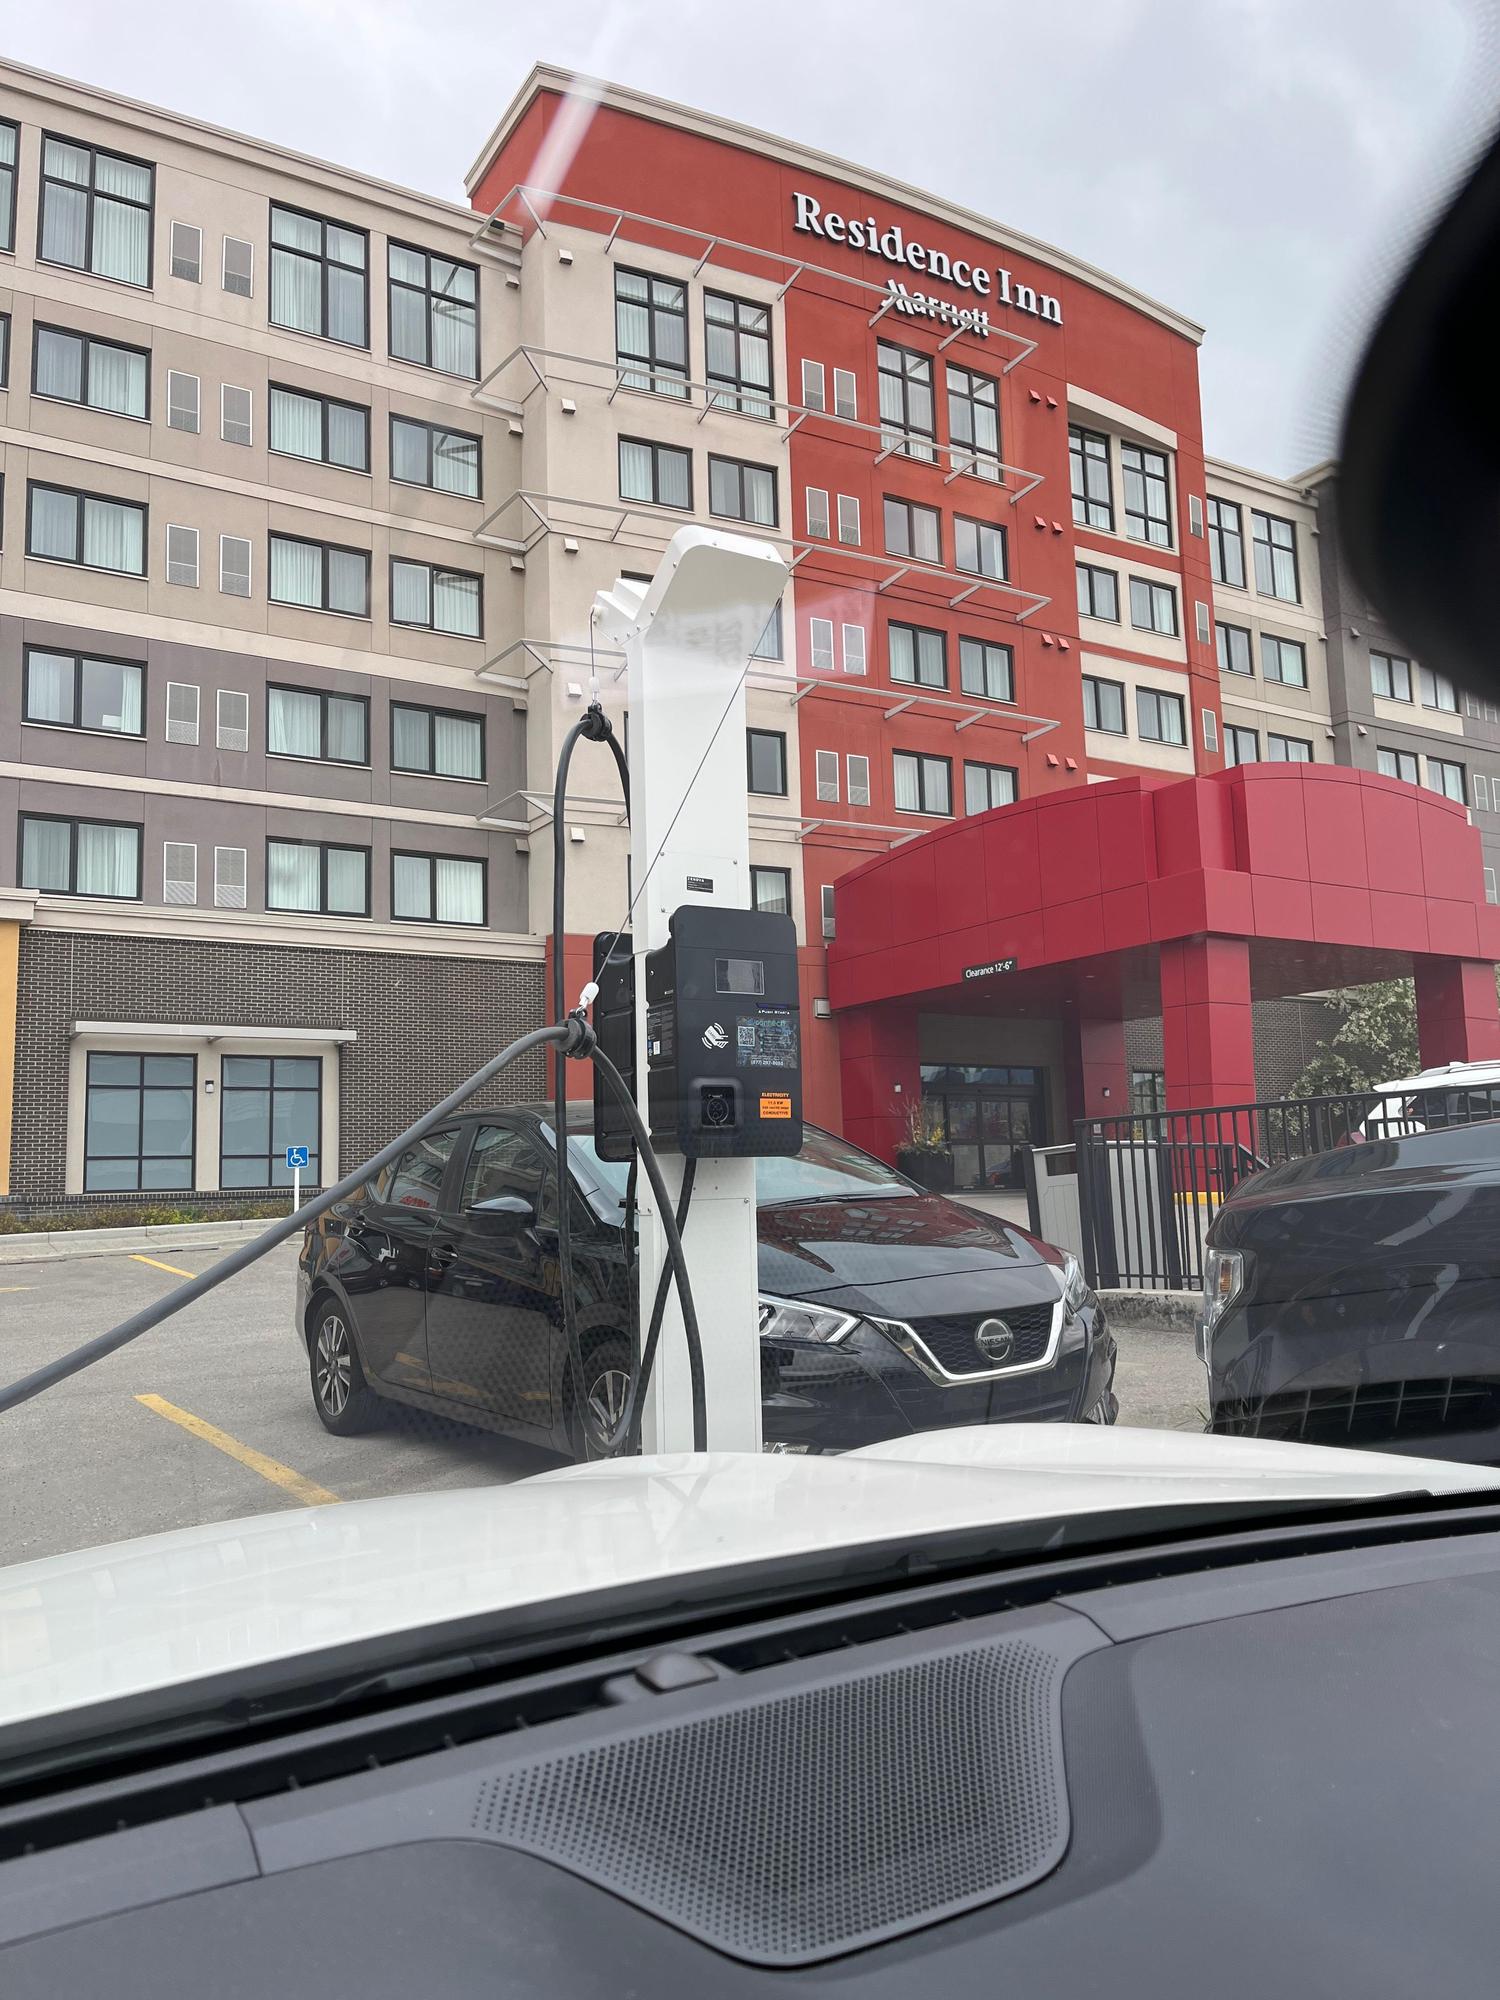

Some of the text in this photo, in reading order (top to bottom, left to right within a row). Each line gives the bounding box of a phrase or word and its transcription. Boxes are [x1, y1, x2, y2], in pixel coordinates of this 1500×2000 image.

[793, 192, 1063, 325] Residence Inn
[880, 279, 990, 337] Marriott
[965, 967, 993, 978] Clearance
[981, 1336, 1010, 1346] NISSAN
